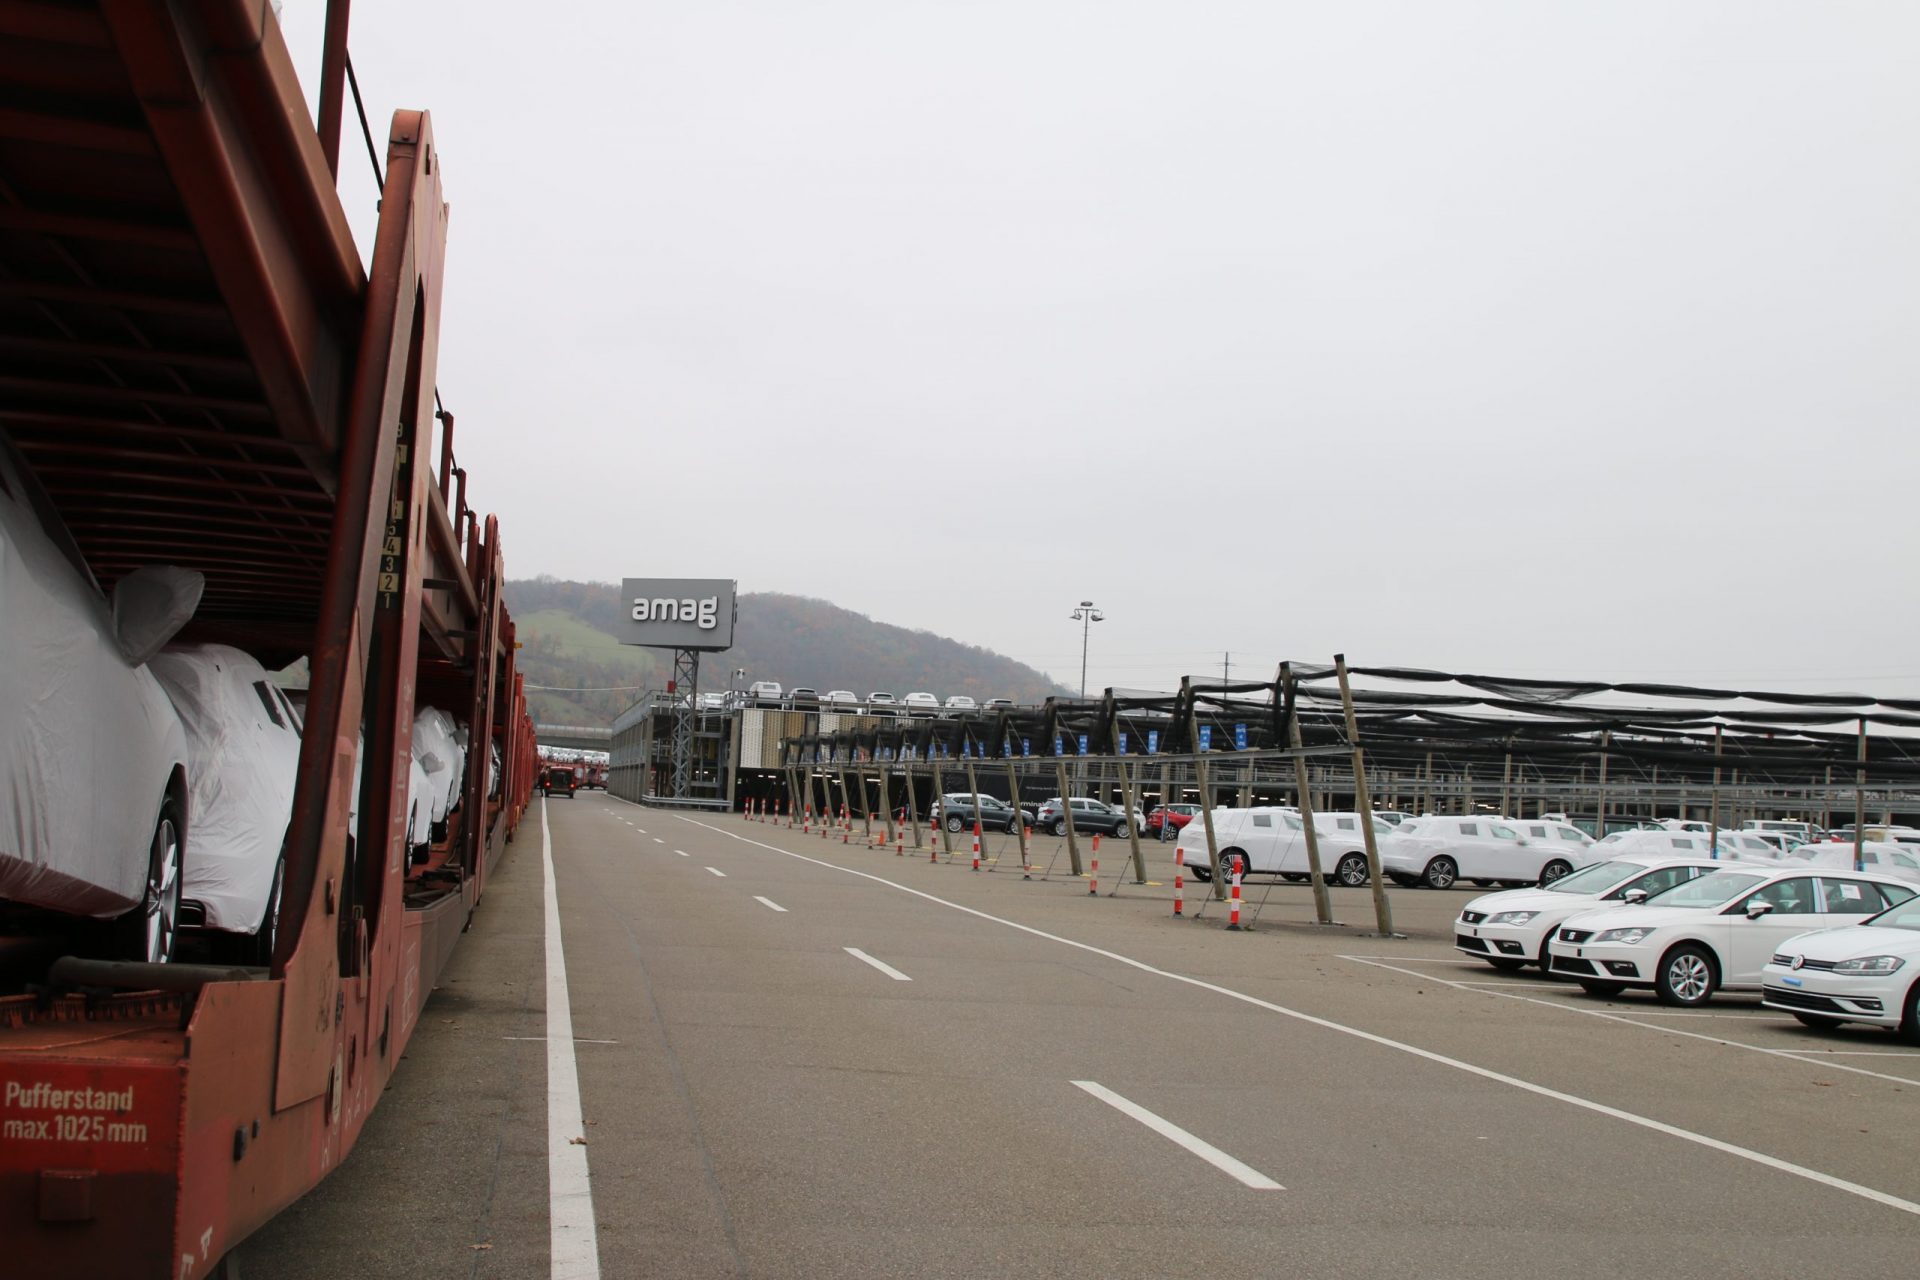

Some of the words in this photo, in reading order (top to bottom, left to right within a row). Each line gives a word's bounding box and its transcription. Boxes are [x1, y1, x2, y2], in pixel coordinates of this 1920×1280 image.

[386, 538, 395, 555] 4
[385, 556, 394, 572] 3
[384, 574, 393, 591] 2
[384, 592, 391, 609] 1
[631, 595, 718, 630] amag
[5, 1081, 134, 1112] Pufferstand
[108, 1122, 148, 1143] mm
